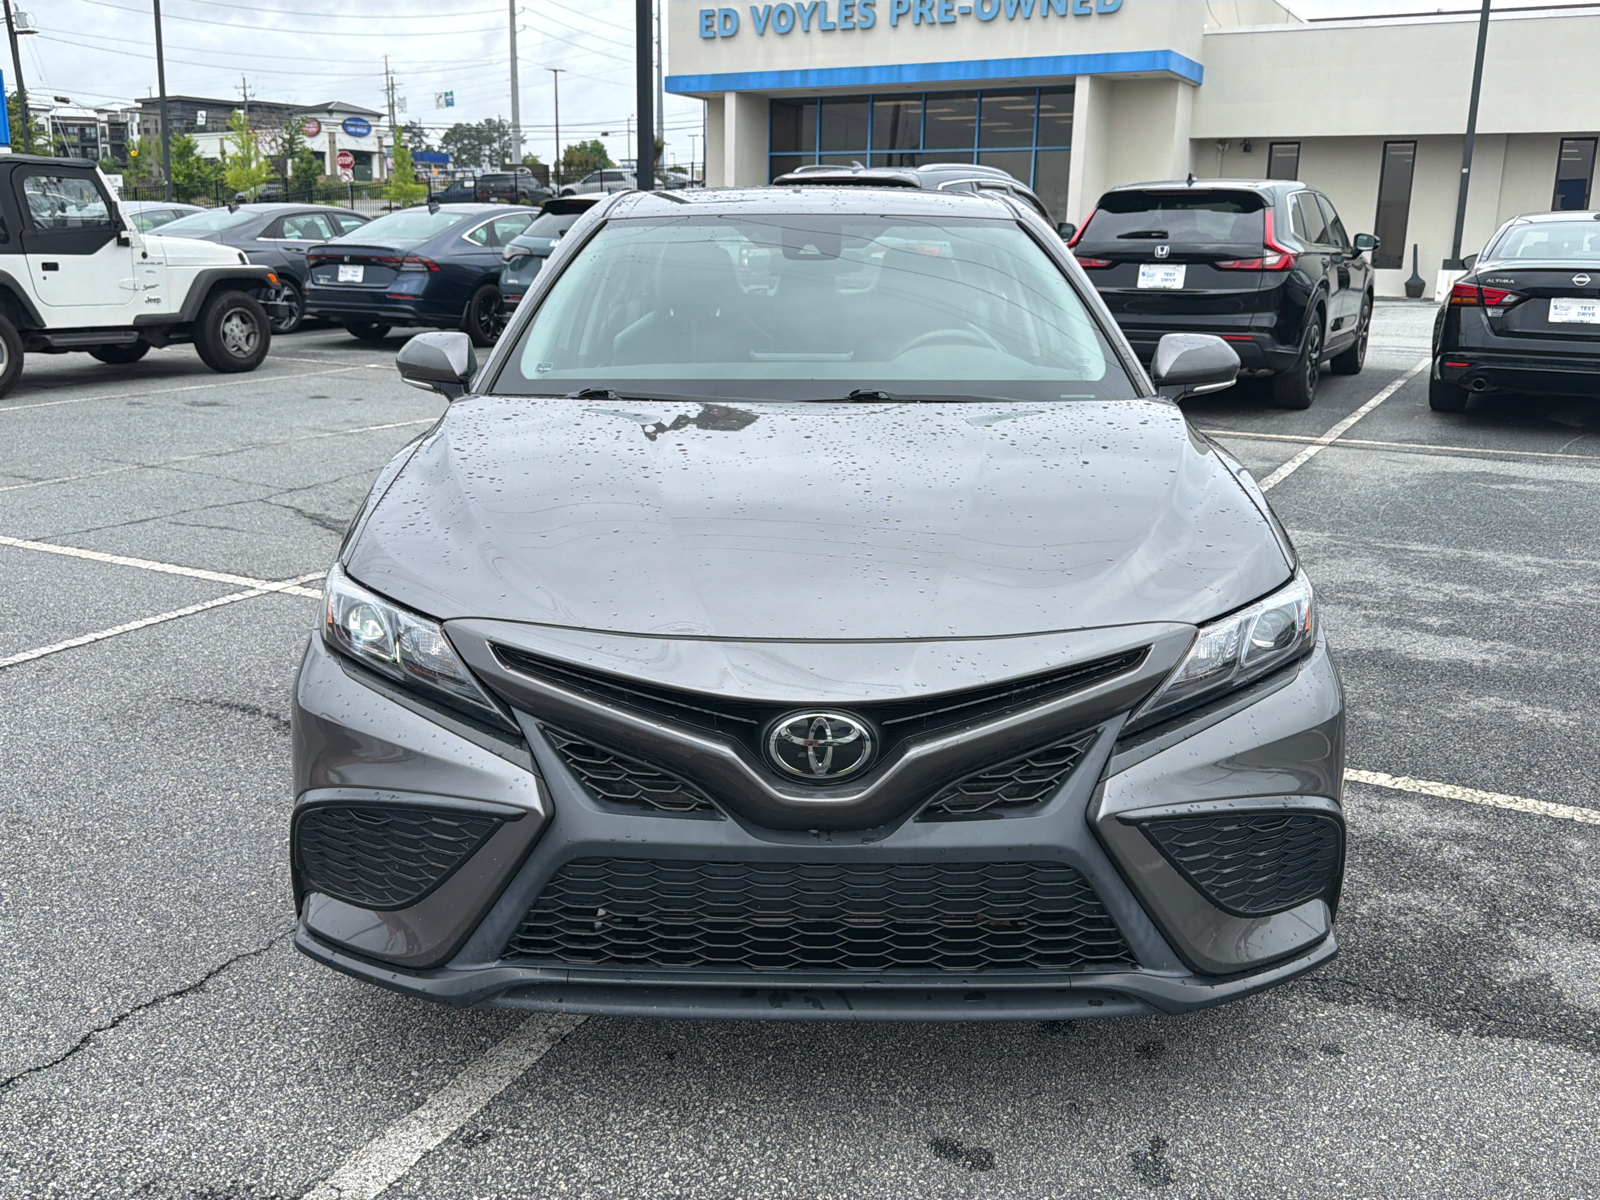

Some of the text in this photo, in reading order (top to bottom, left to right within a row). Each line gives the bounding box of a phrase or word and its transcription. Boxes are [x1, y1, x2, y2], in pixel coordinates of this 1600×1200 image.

[698, 9, 740, 39] ED
[749, 0, 880, 37] VOYLES
[337, 156, 352, 164] STOP
[144, 296, 161, 304] Jeep
